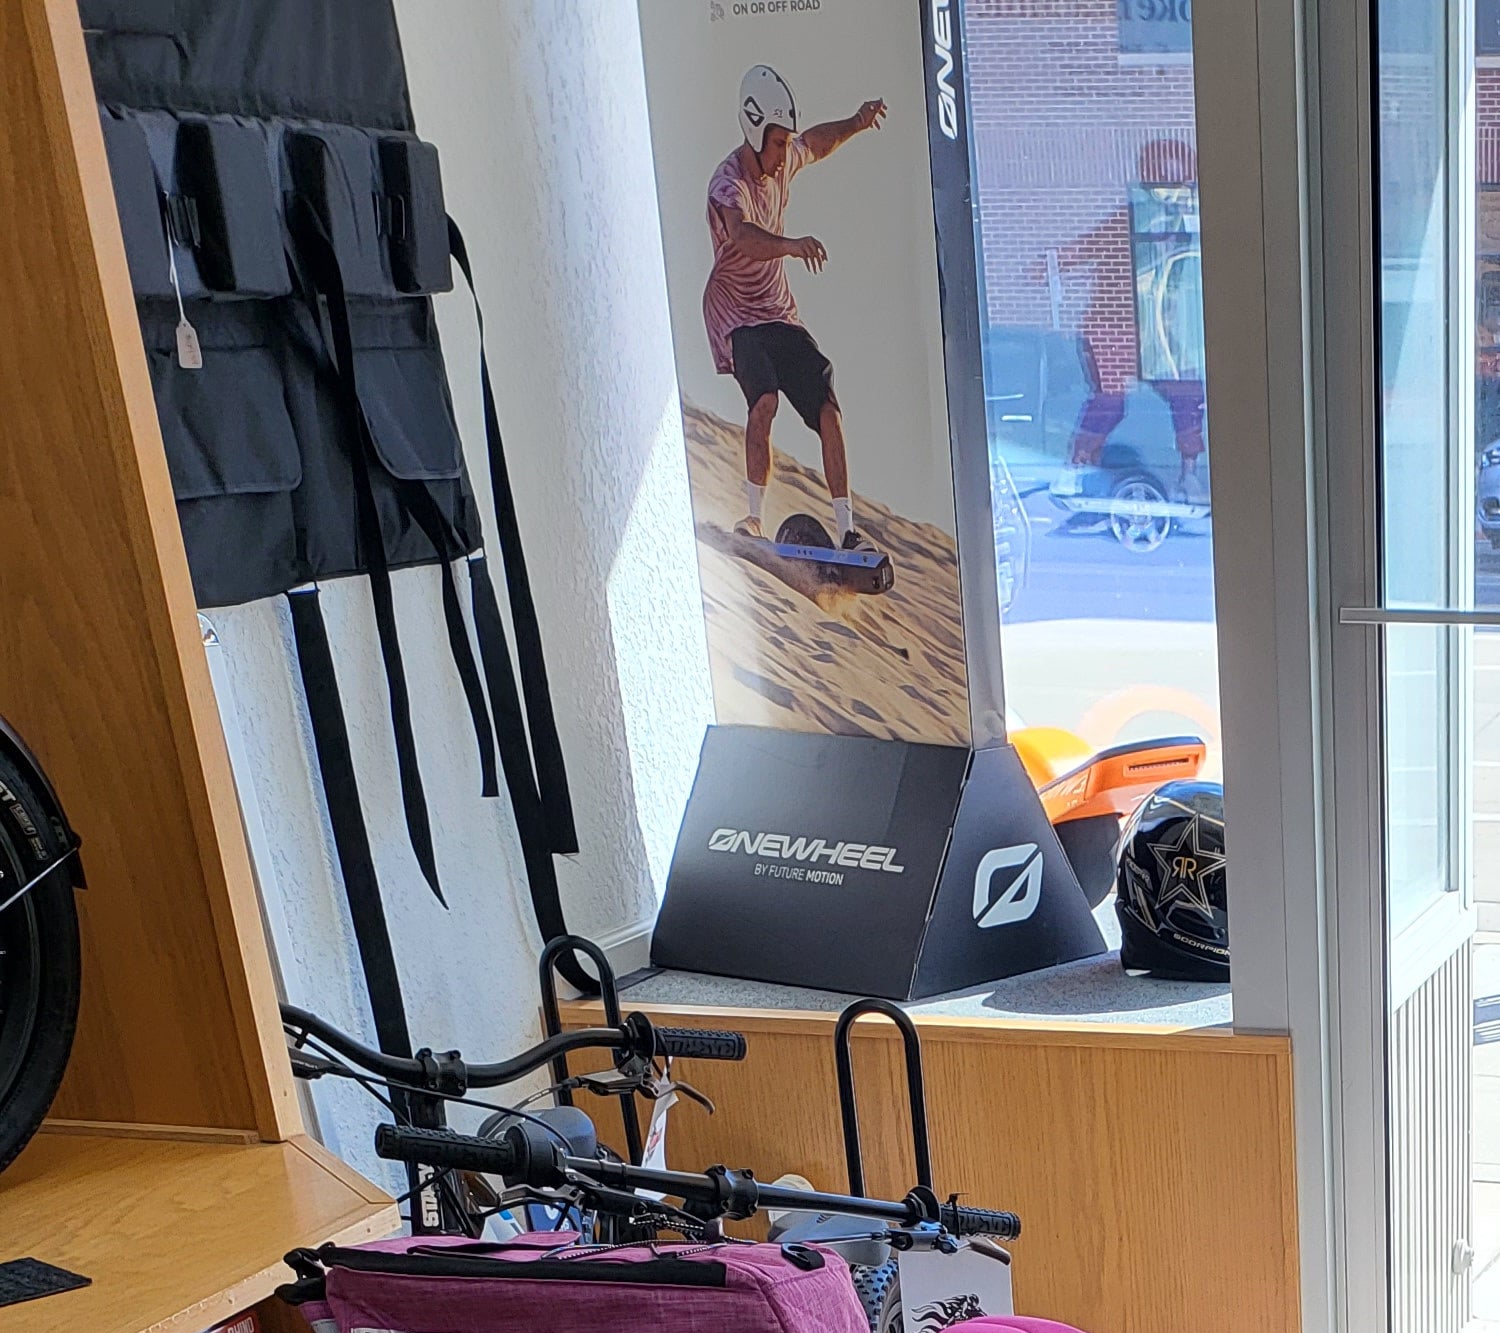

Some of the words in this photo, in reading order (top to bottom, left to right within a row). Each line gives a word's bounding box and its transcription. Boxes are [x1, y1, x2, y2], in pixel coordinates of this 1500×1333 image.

[733, 3, 748, 15] ON
[751, 2, 766, 14] OR
[768, 1, 788, 13] OFF
[790, 0, 820, 11] ROAD
[708, 828, 904, 872] ONEWHEEL
[754, 863, 766, 876] BY
[769, 866, 805, 881] FUTURE
[806, 869, 844, 886] MOTION
